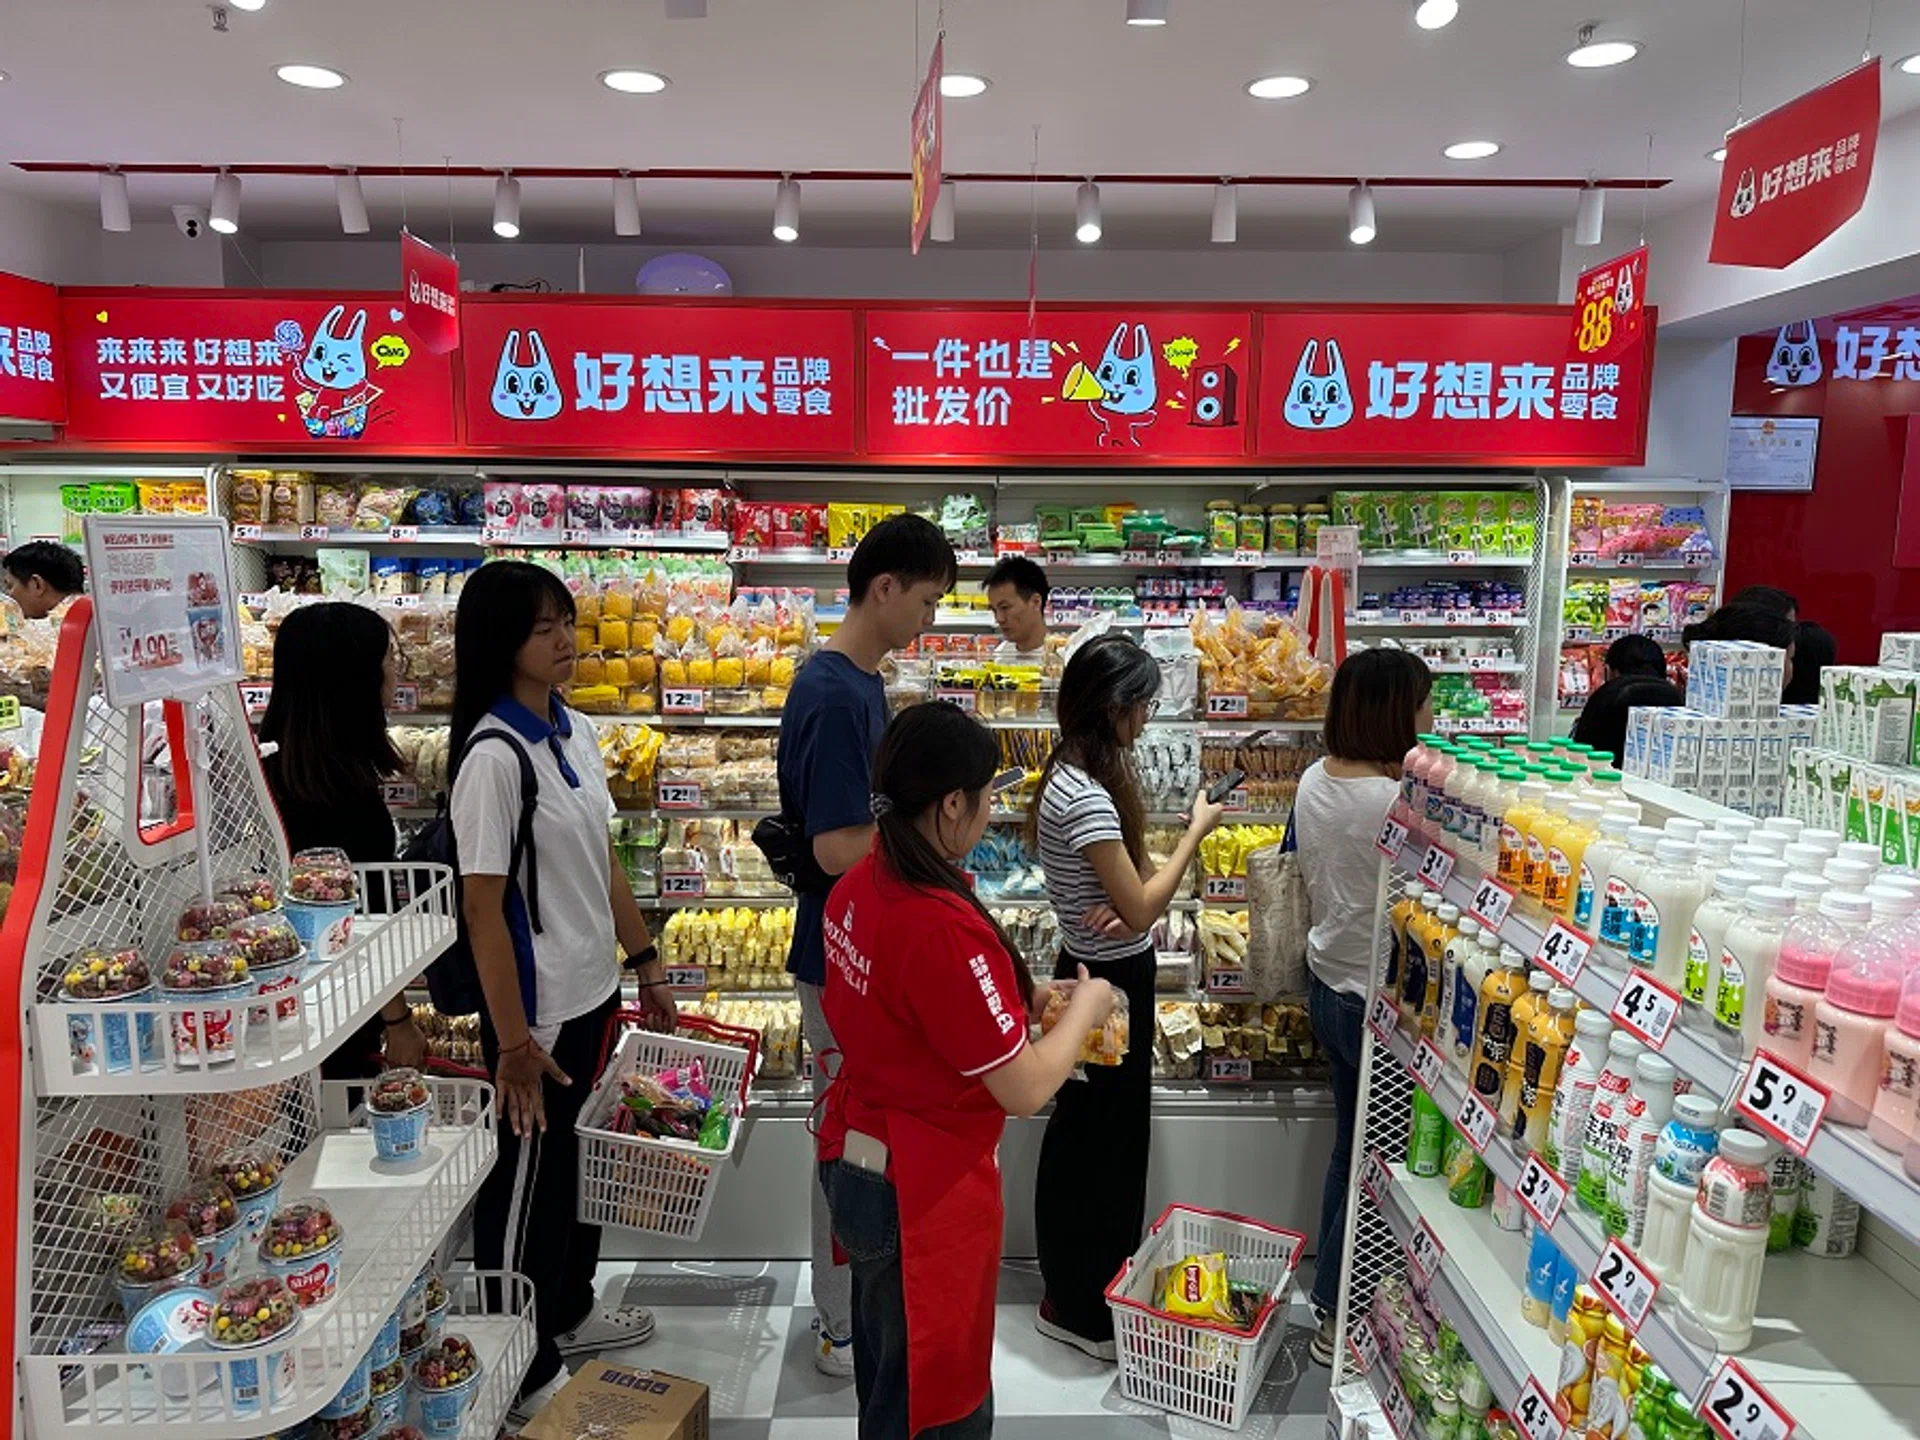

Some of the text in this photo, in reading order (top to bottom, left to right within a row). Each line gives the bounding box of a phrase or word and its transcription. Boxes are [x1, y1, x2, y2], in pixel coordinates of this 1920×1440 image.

[1760, 147, 1834, 204] 好想来
[17, 327, 52, 355] 品牌
[97, 337, 284, 367] 来来来 好想来
[18, 355, 55, 383] 零食
[772, 357, 831, 386] 品牌
[892, 338, 1053, 380] 一件也是
[100, 373, 286, 403] 又便宜 又好吃
[574, 352, 768, 416] 好想来
[1365, 361, 1555, 420] 好想来
[1561, 362, 1620, 392] 品牌
[772, 387, 832, 416] 零食
[892, 386, 1012, 427] 批发价
[1560, 392, 1619, 421] 零食
